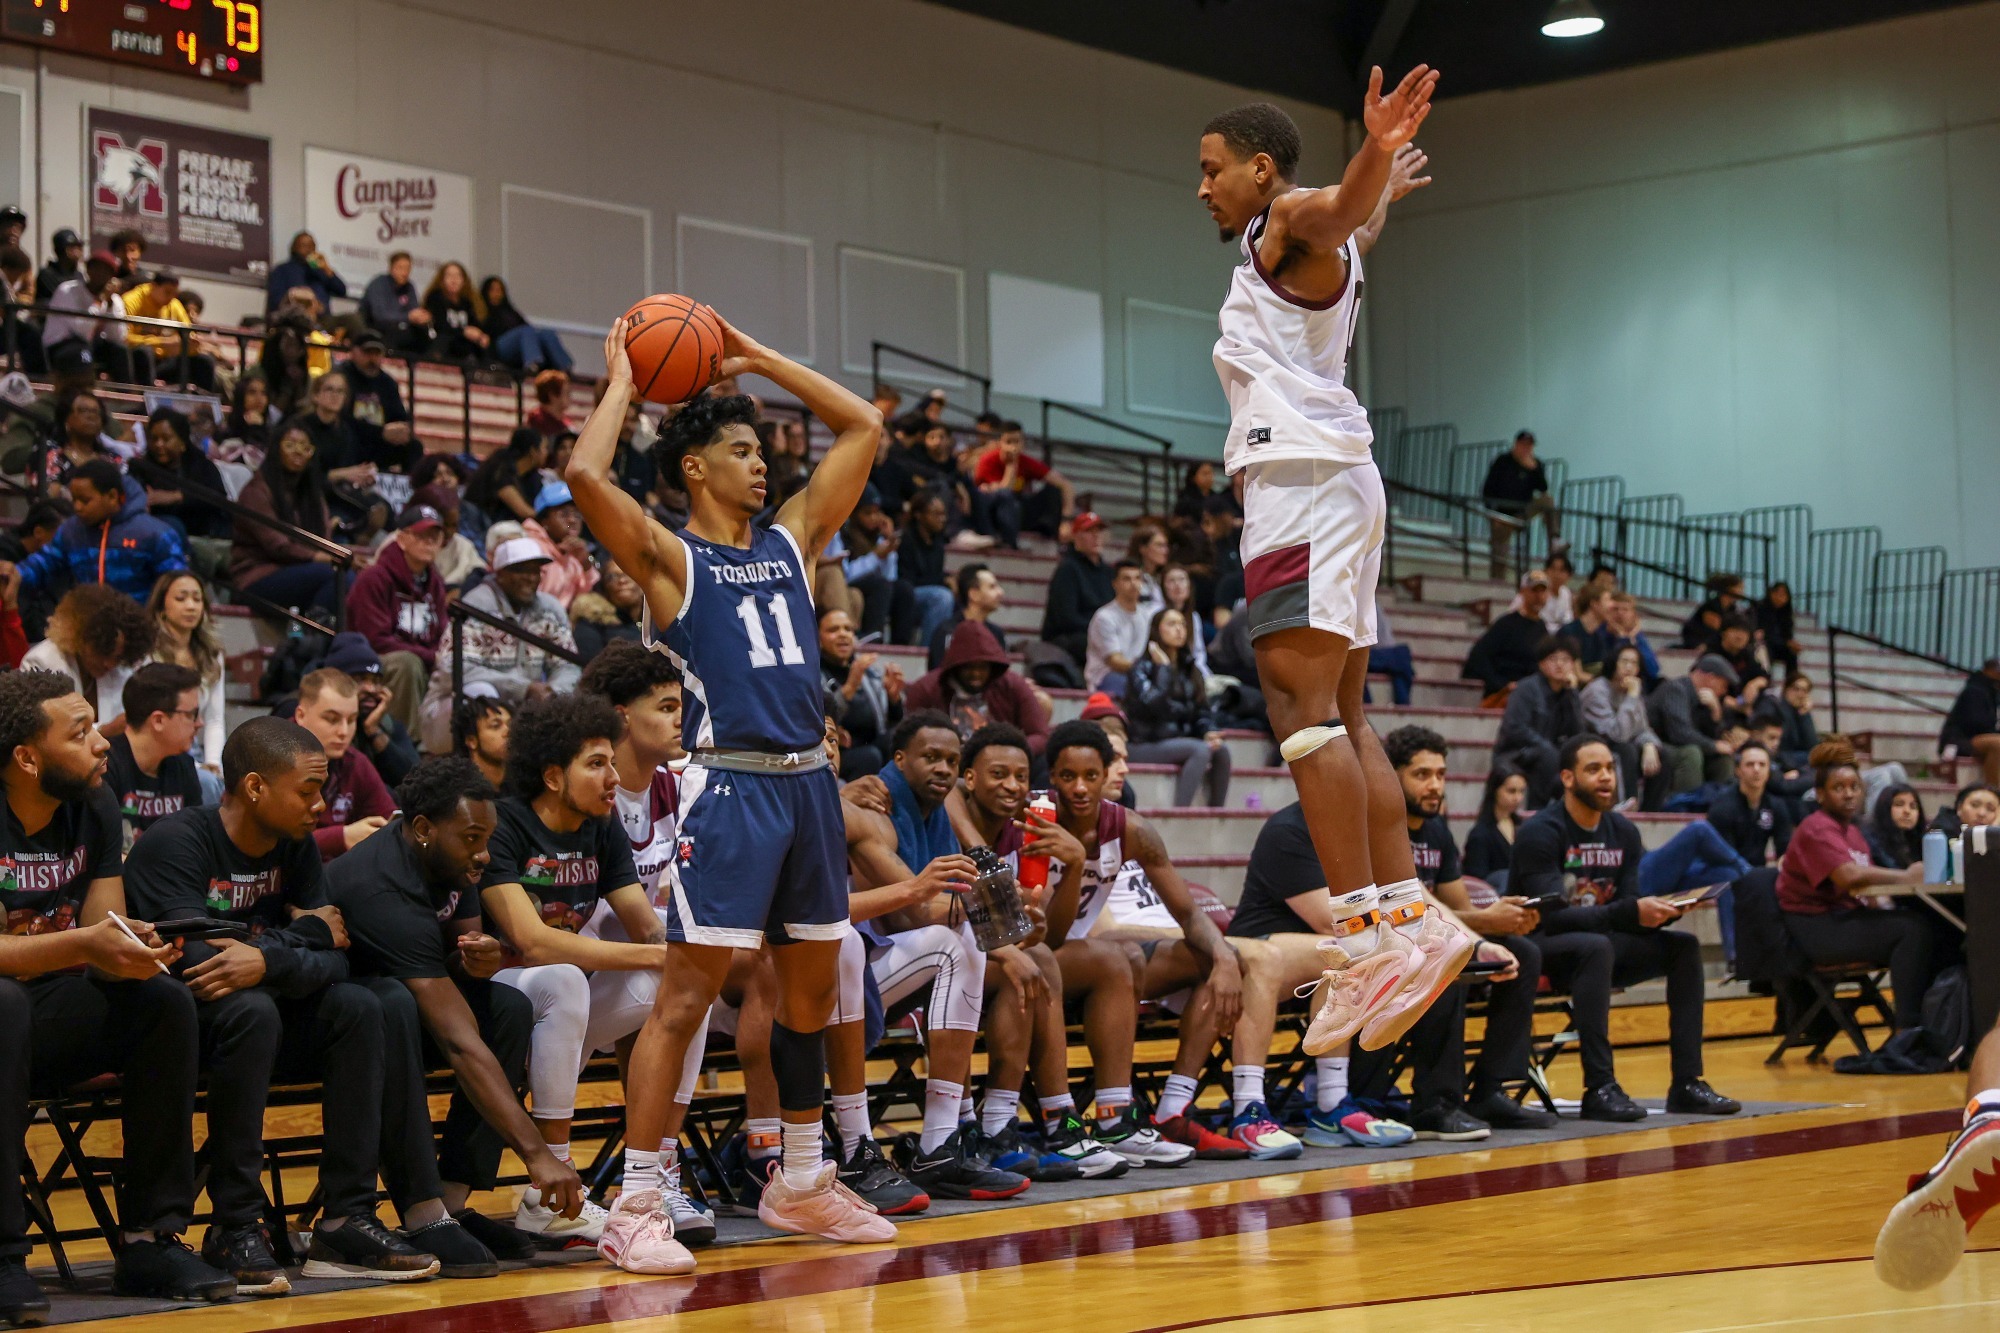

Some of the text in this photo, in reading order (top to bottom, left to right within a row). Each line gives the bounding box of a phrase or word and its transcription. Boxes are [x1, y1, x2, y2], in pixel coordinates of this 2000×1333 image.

[111, 29, 163, 55] period
[212, 0, 259, 53] 73
[176, 30, 197, 65] 4
[178, 150, 258, 184] PREPARE.
[178, 193, 264, 226] PERFORM.
[335, 163, 437, 220] Campus
[377, 207, 430, 244] Store
[709, 560, 793, 584] TORONTO
[736, 593, 806, 669] 11
[16, 849, 84, 888] HISTRY
